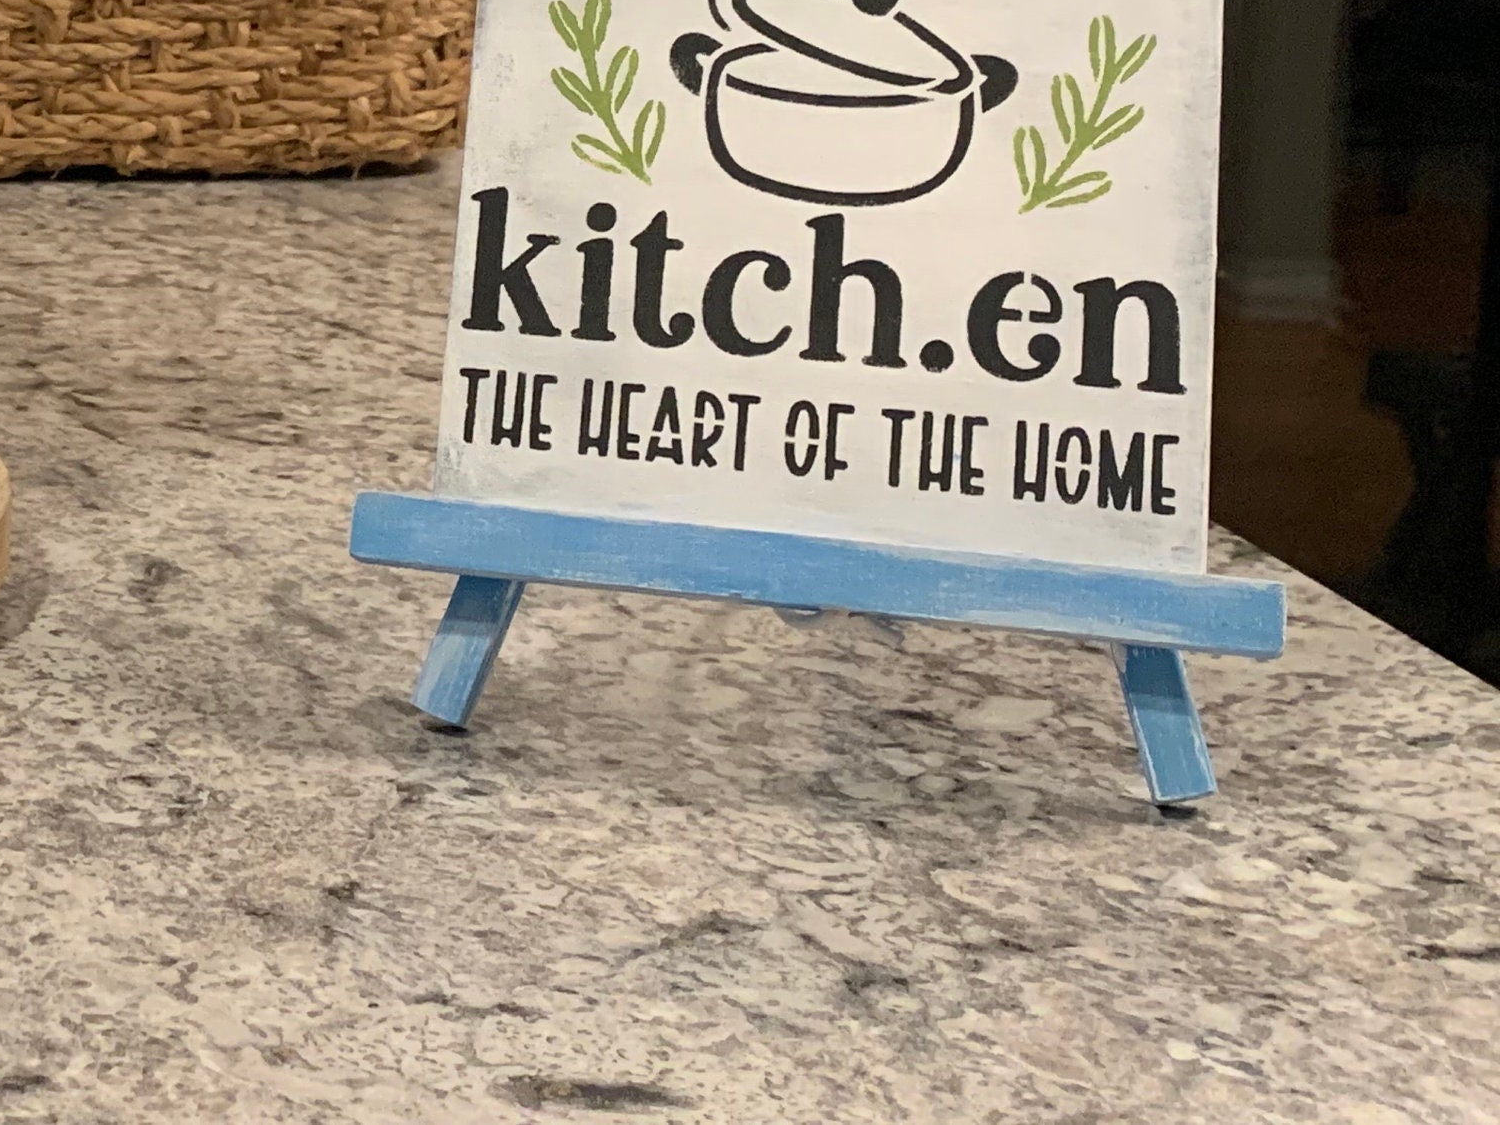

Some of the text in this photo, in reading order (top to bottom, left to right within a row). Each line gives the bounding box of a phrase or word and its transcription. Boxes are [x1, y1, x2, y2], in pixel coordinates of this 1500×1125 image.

[462, 187, 1187, 394] kitch.en
[460, 368, 1180, 516] THE HEART OF THE HOME
